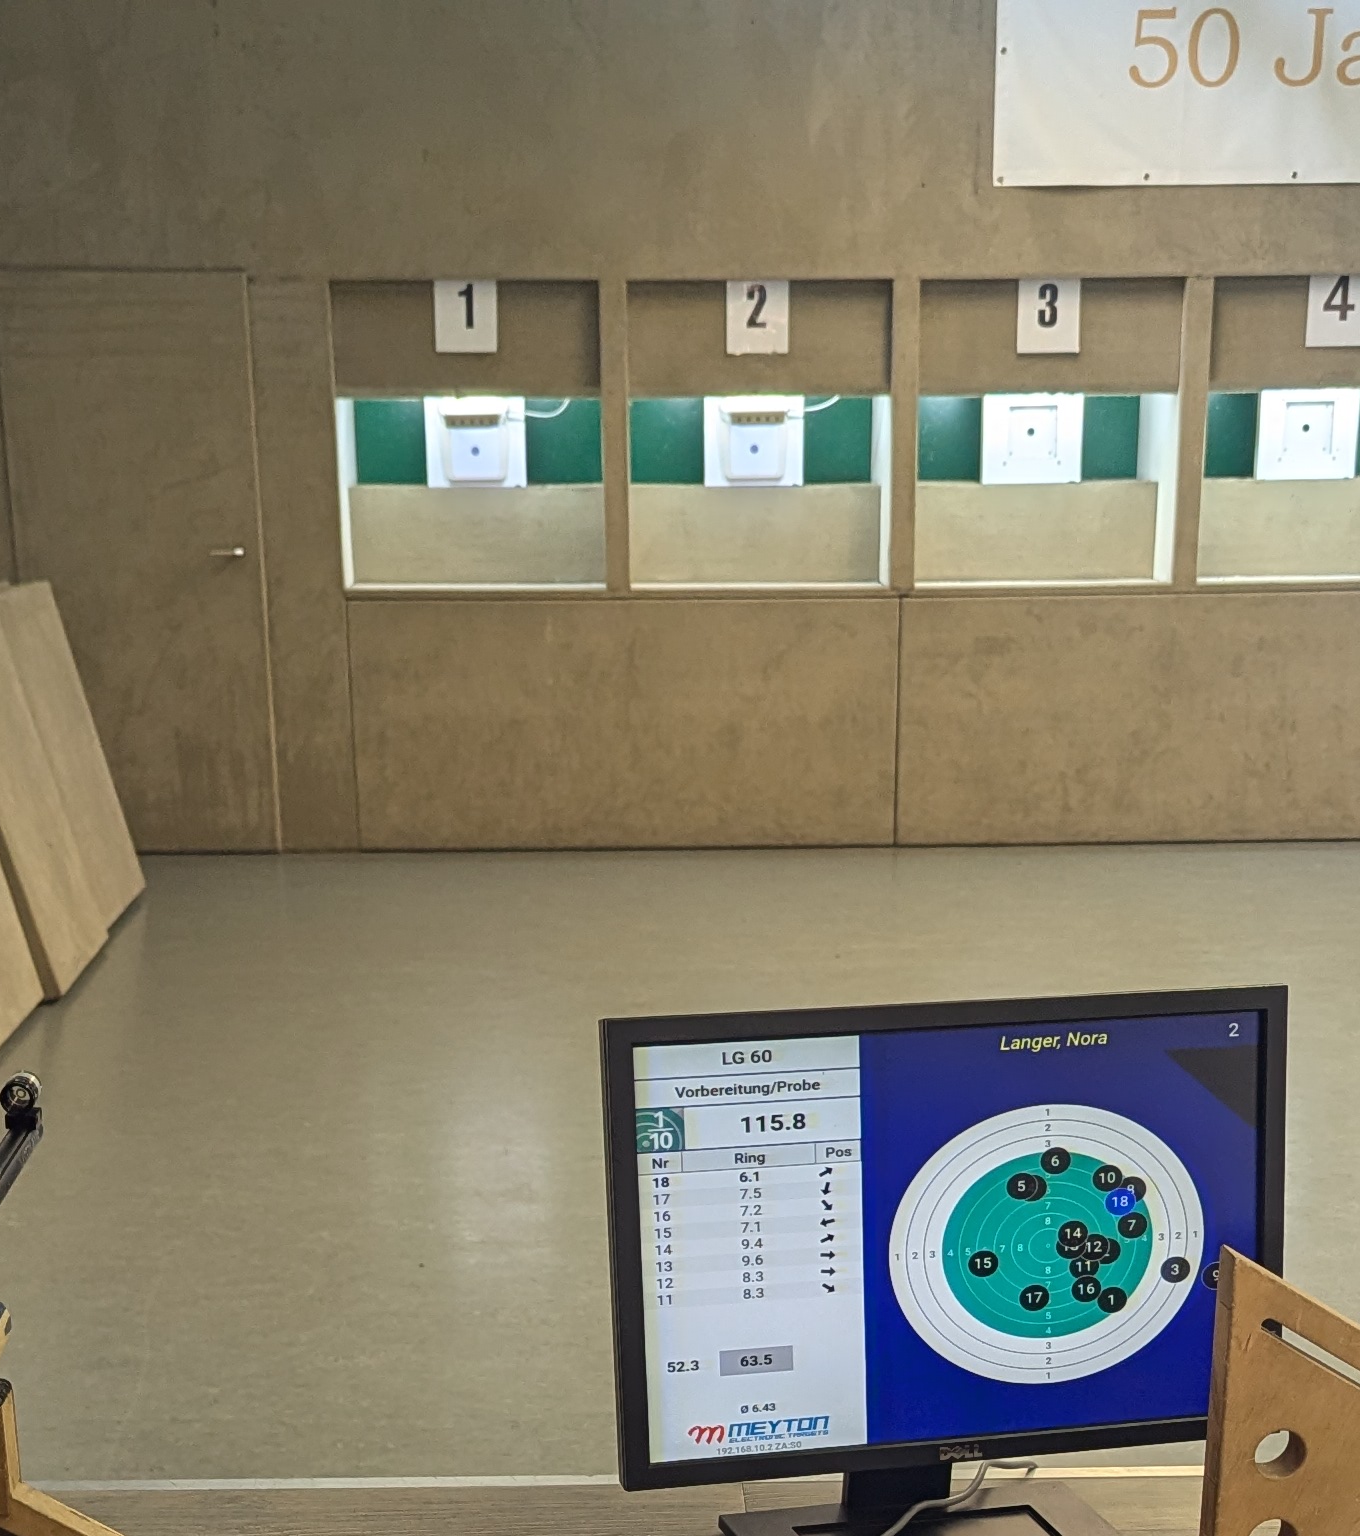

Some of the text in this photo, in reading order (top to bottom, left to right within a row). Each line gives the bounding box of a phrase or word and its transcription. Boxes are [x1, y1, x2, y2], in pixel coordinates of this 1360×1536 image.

[1128, 7, 1240, 89] 50
[1323, 275, 1356, 321] 4
[457, 284, 474, 330] 1
[746, 284, 768, 329] 2
[1039, 284, 1059, 328] 3
[1228, 1022, 1240, 1038] 2
[999, 1031, 1108, 1053] Langer, Nora
[722, 1049, 772, 1066] LG 60
[675, 1079, 821, 1099] Vorbereitung/Probe
[1045, 1108, 1050, 1117] 1
[653, 1111, 663, 1128] 1
[740, 1113, 806, 1133] 115.8
[1044, 1124, 1052, 1132] 2
[649, 1132, 674, 1150] 10
[1044, 1140, 1051, 1148] 3
[652, 1147, 852, 1170] Nr Ring Pos
[1051, 1155, 1060, 1167] 6
[652, 1171, 760, 1189] 18 6.1
[1098, 1171, 1116, 1184] 10
[1017, 1180, 1026, 1192] 5
[653, 1187, 762, 1206] 17 7.5
[1111, 1195, 1129, 1208] 18
[653, 1204, 763, 1222] 16 7.2
[654, 1221, 761, 1239] 15 7.1
[1127, 1219, 1136, 1231] 7
[1065, 1227, 1082, 1239] 14
[1157, 1232, 1165, 1241] 3
[1174, 1231, 1182, 1240] 2
[1192, 1230, 1198, 1239] 1
[655, 1237, 764, 1256] 14 9.4
[946, 1249, 954, 1257] 4
[1086, 1240, 1102, 1253] 12
[894, 1253, 900, 1261] 1
[911, 1251, 919, 1260] 2
[929, 1250, 936, 1259] 3
[655, 1254, 764, 1273] 13 9.6
[974, 1257, 992, 1270] 15
[1075, 1261, 1091, 1273] 11
[1170, 1264, 1179, 1276] 3
[656, 1271, 764, 1290] 12 8.3
[1077, 1282, 1095, 1295] 16
[657, 1287, 765, 1306] 11 8.3
[1025, 1291, 1043, 1304] 17
[1109, 1294, 1115, 1306] 1
[1045, 1341, 1052, 1350] 3
[667, 1353, 773, 1374] 52.3 63.5
[1045, 1356, 1052, 1365] 2
[1045, 1371, 1051, 1380] 1
[751, 1402, 776, 1414] 6.43
[728, 1415, 831, 1438] MEYTON
